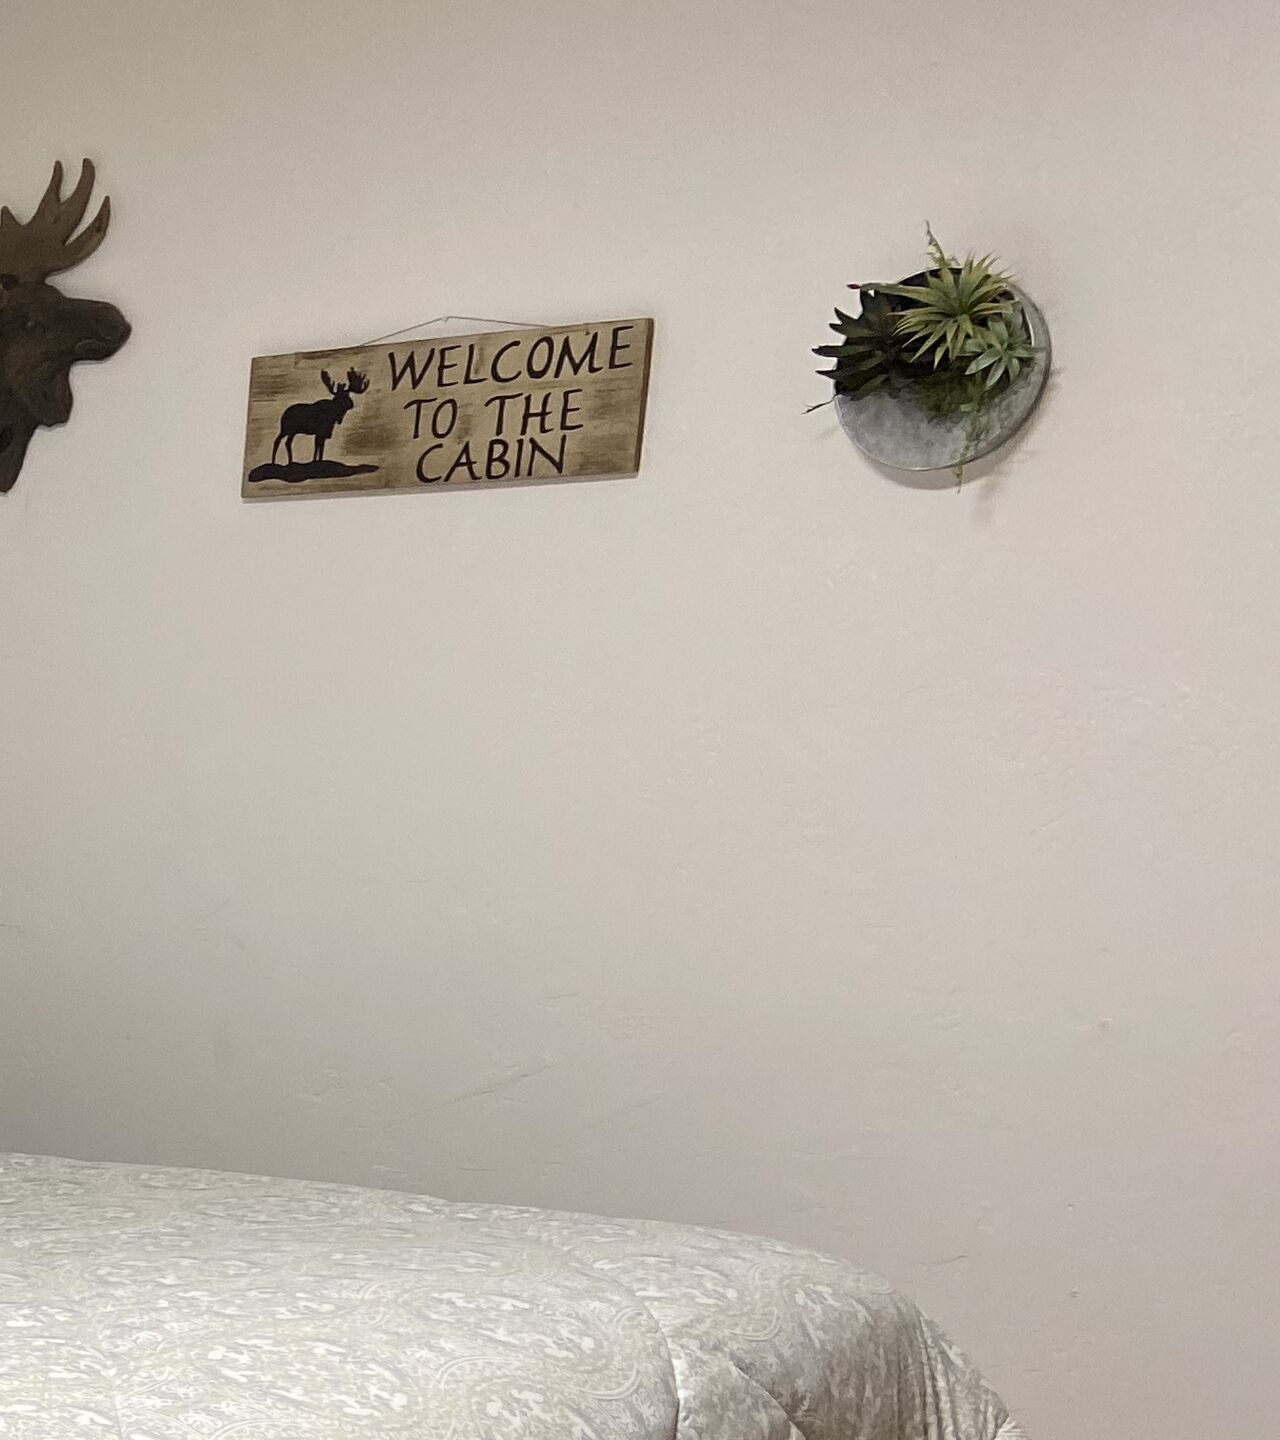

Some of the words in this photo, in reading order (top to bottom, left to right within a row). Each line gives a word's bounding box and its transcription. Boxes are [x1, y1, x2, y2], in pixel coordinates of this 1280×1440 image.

[388, 326, 634, 391] WELCOME
[404, 398, 458, 439] TO
[485, 389, 584, 436] THE
[416, 435, 567, 483] CABIN
